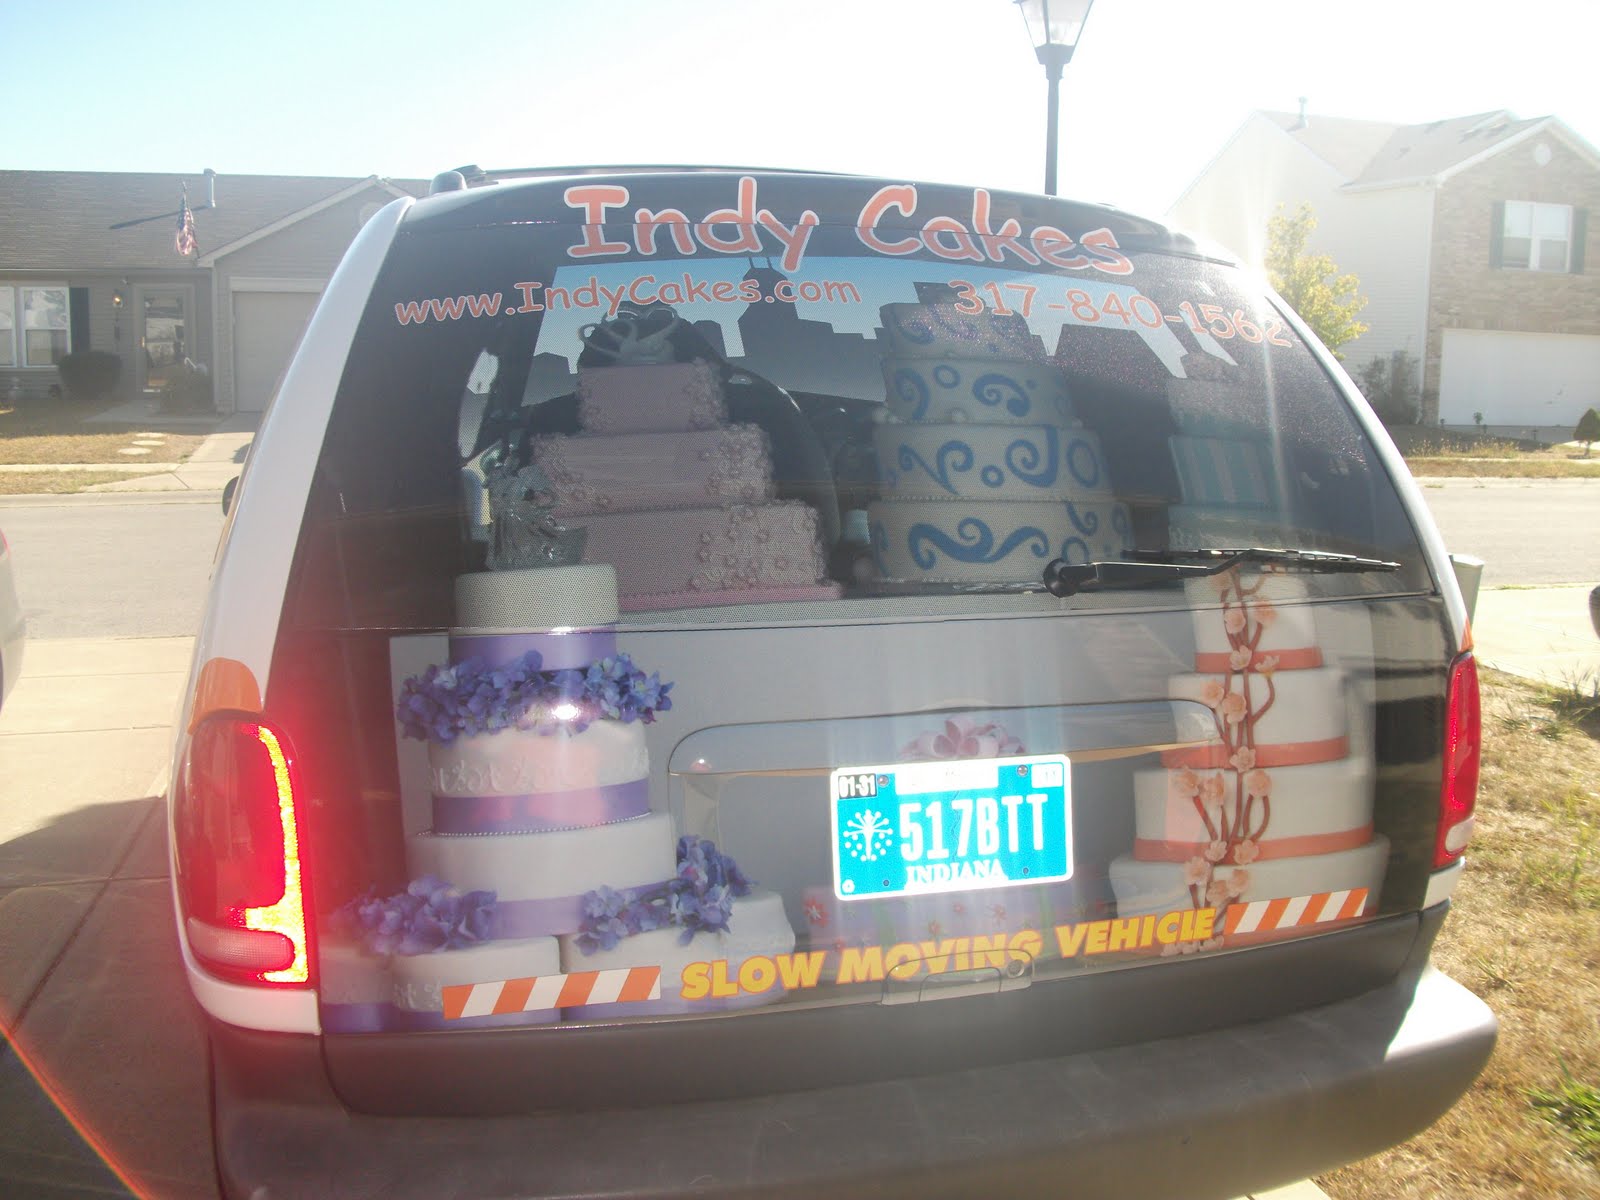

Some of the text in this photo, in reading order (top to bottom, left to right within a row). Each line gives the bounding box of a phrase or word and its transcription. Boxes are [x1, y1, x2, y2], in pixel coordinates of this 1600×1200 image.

[564, 177, 1134, 275] Indy Cakes
[395, 273, 861, 325] www.IndyCakes.com
[948, 280, 1292, 348] 317-840-1562
[900, 794, 1048, 861] 517BTT
[905, 859, 1005, 884] INDIANA
[680, 908, 1217, 999] SLOW MOVING VEHICLE
